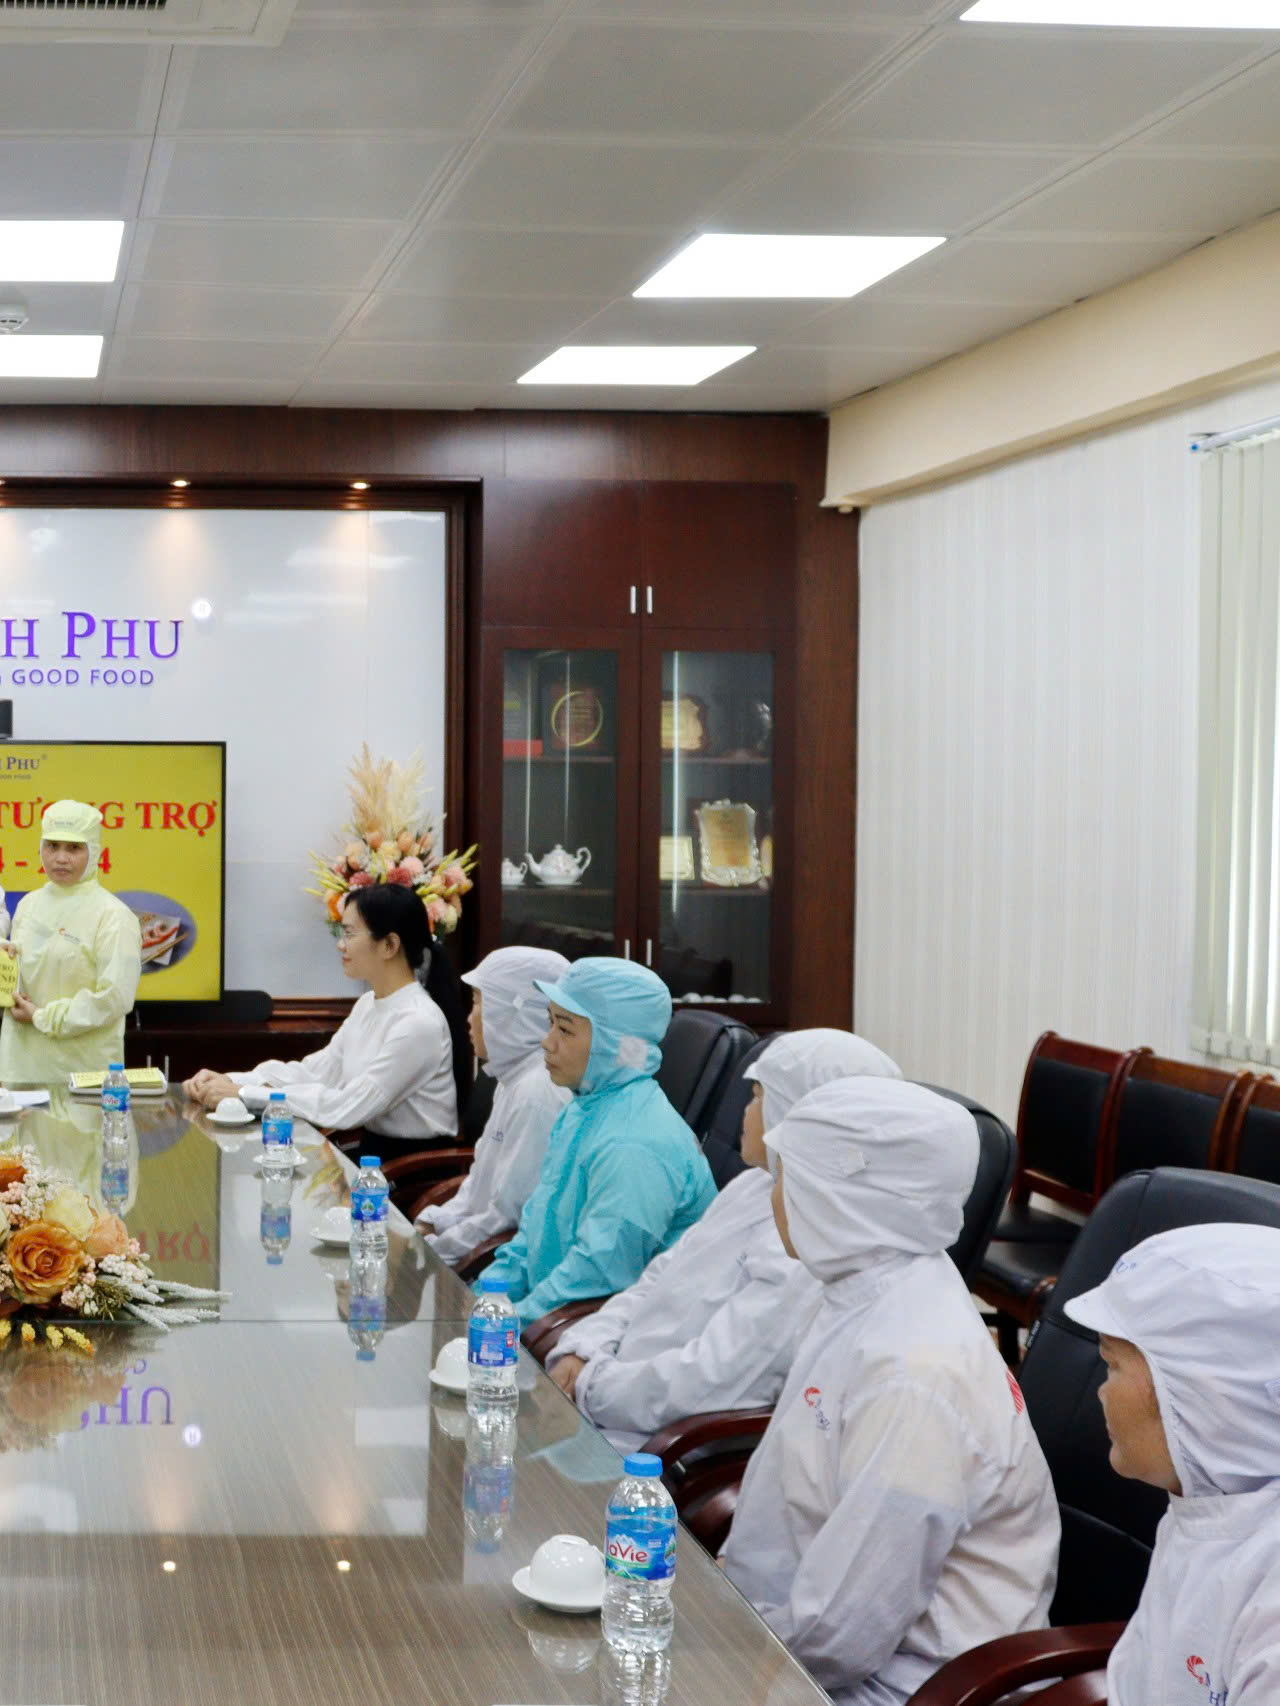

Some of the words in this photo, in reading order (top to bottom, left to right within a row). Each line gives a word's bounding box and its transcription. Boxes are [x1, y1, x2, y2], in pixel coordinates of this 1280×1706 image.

[61, 611, 184, 660] PHU
[12, 668, 80, 686] GOOD
[90, 668, 156, 686] FOOD
[6, 756, 41, 770] PHU
[135, 799, 218, 837] TRỢ
